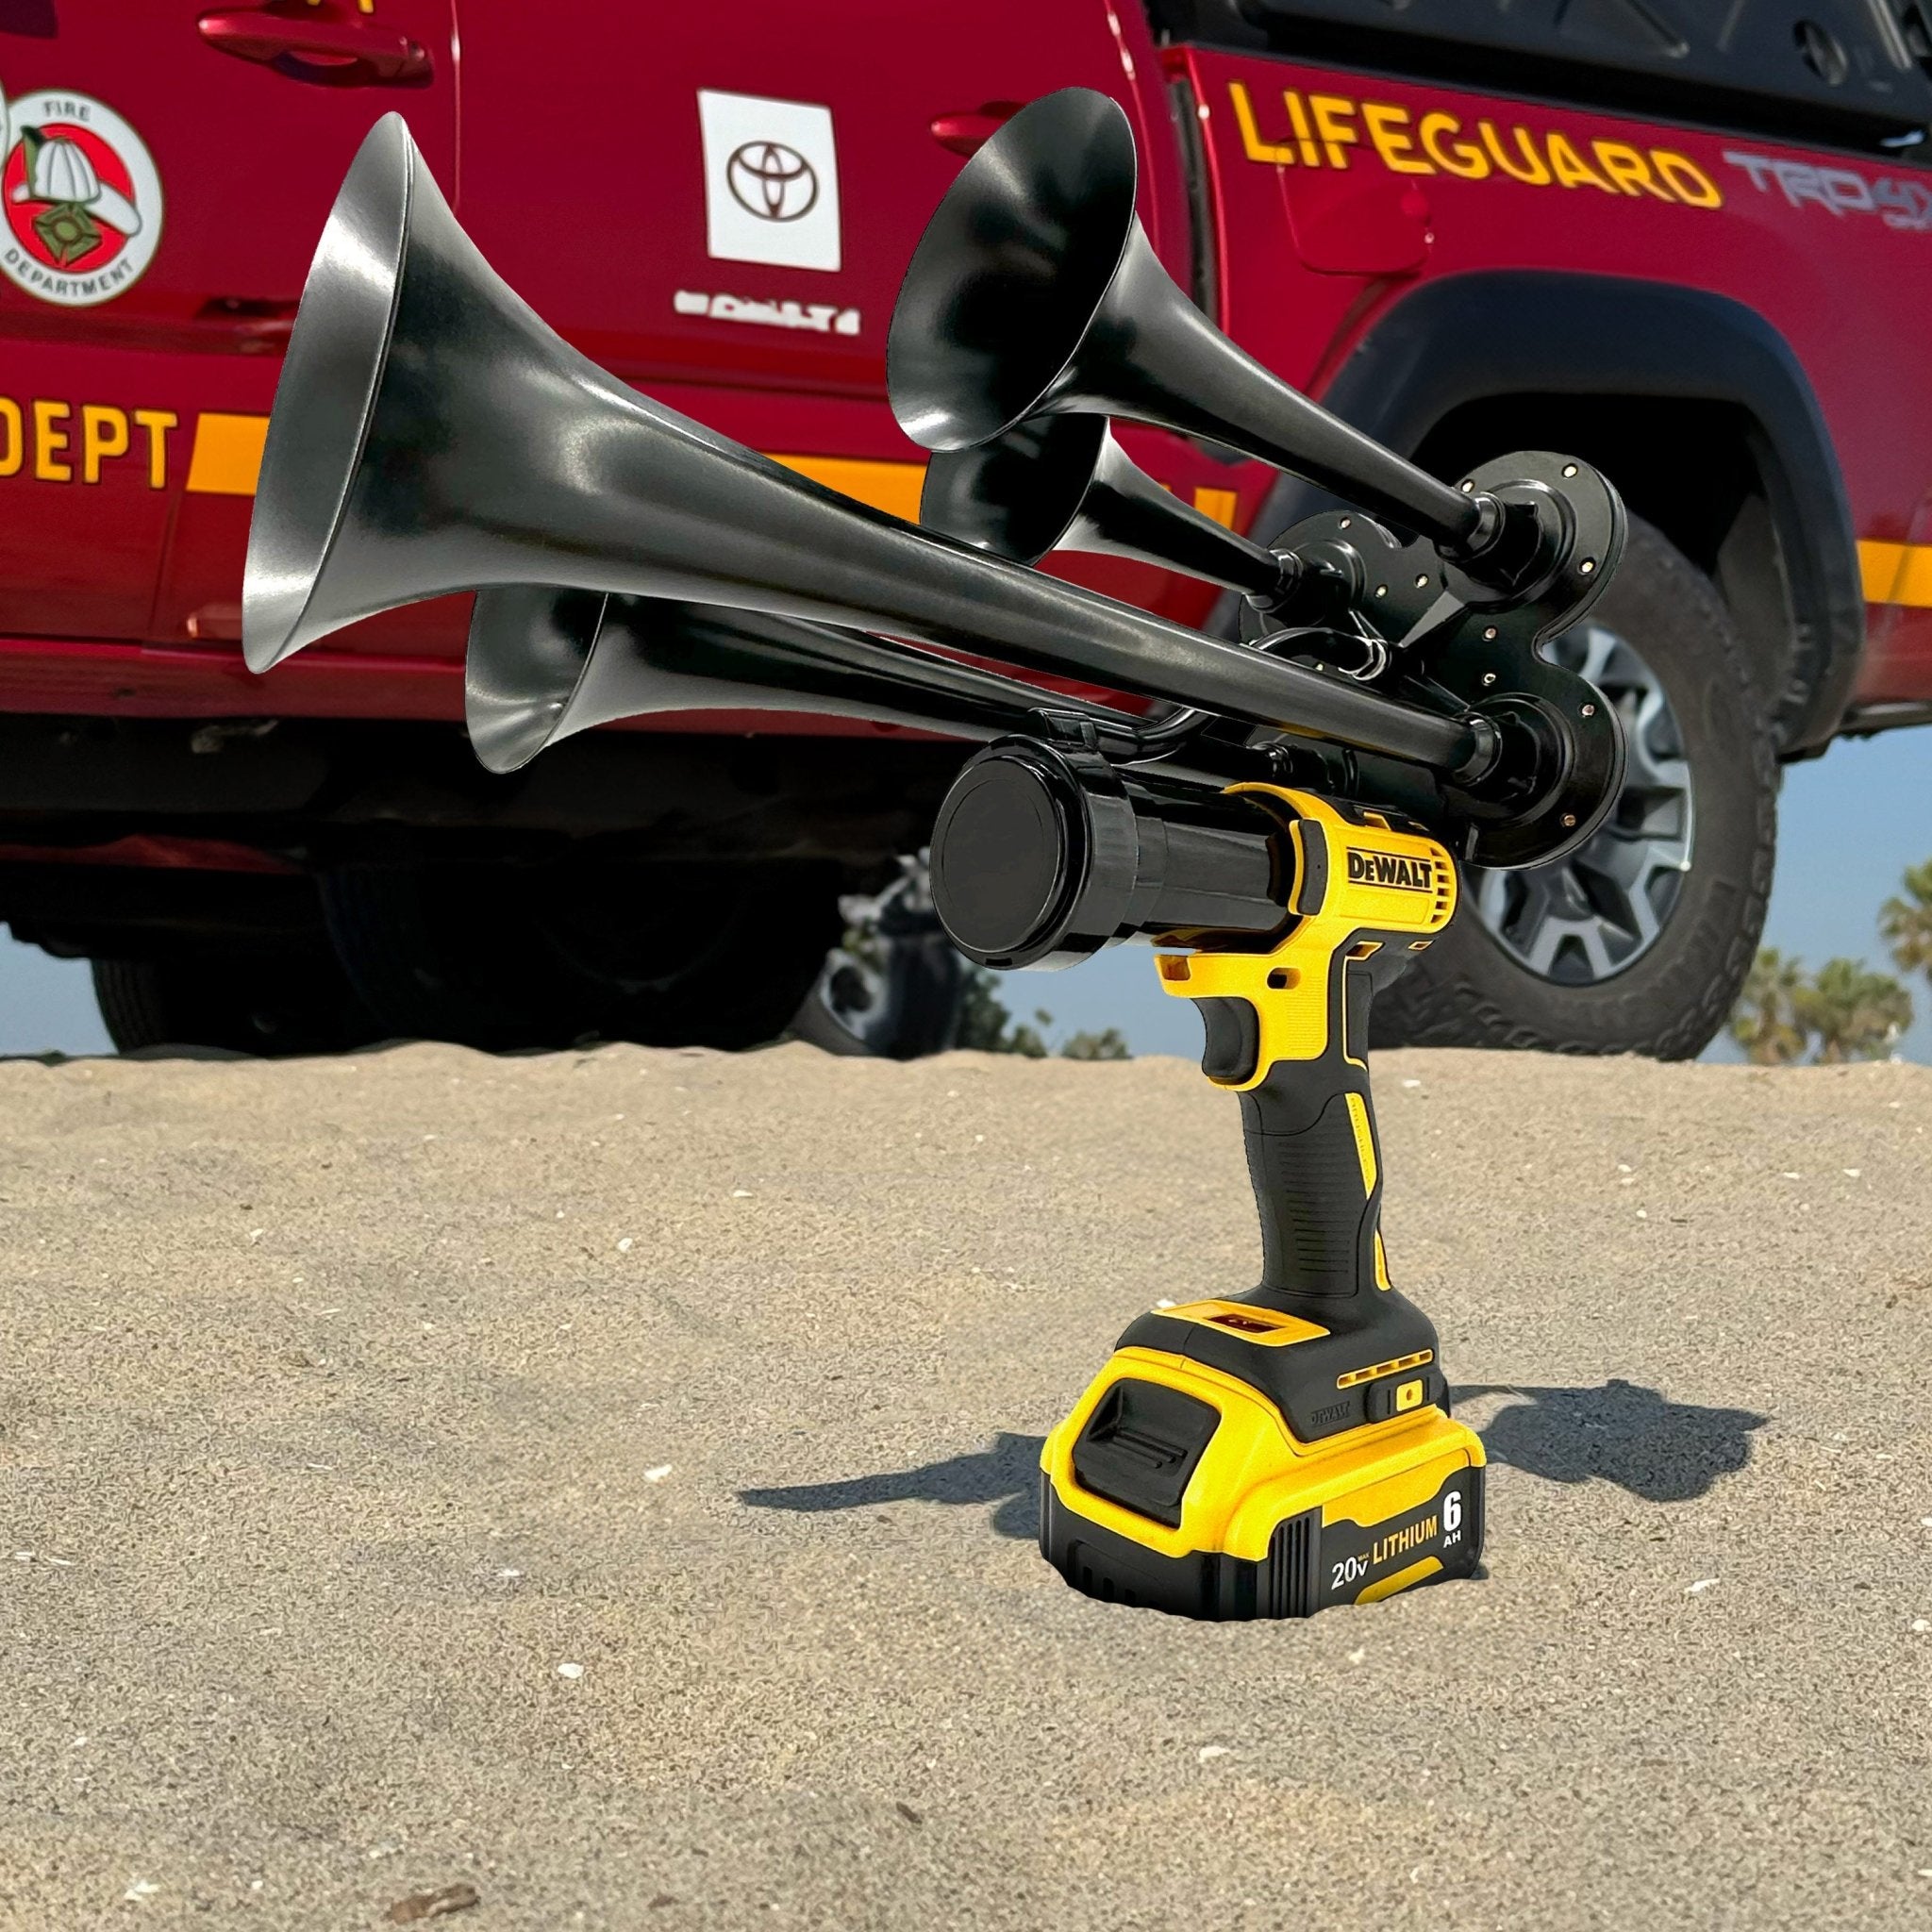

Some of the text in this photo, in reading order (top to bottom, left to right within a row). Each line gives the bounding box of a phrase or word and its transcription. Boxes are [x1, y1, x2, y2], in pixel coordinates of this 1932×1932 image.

[43, 100, 92, 122] FIRE
[1229, 82, 1724, 209] LIFEGUARD
[1722, 150, 1875, 217] TRD
[4, 247, 134, 297] DEPARTMENT
[0, 397, 178, 490] DEPT
[1347, 851, 1433, 889] DEWALT
[1443, 1491, 1462, 1532] 6
[1373, 1515, 1438, 1565] LITHIUM
[1442, 1530, 1462, 1549] AH
